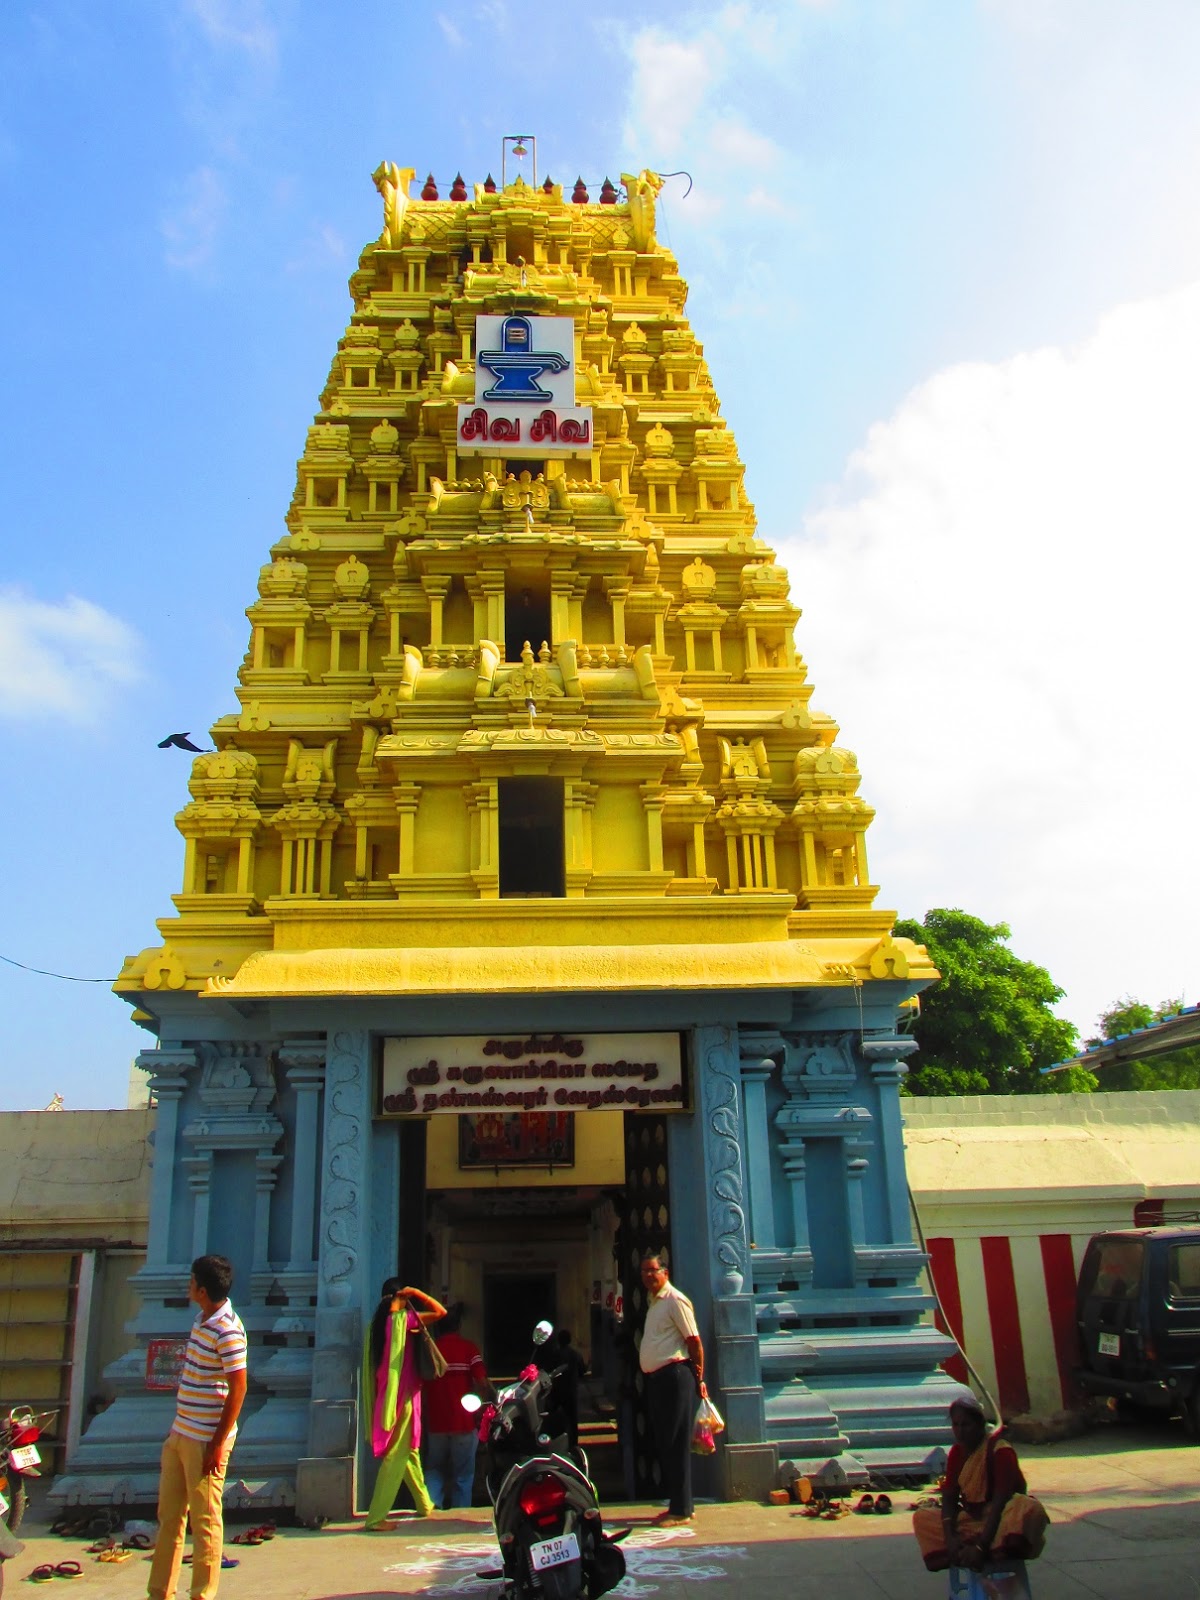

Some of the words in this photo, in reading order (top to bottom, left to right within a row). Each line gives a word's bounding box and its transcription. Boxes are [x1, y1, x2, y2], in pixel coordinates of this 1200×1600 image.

[460, 408, 521, 441] சிவ
[529, 409, 589, 443] சிவ
[483, 1033, 584, 1059] அருள்மிகு
[446, 1060, 587, 1085] கருணாம்பிகா
[540, 1556, 550, 1565] CJ
[552, 1549, 570, 1562] 3513
[541, 1543, 552, 1554] TN
[554, 1540, 562, 1551] 07
